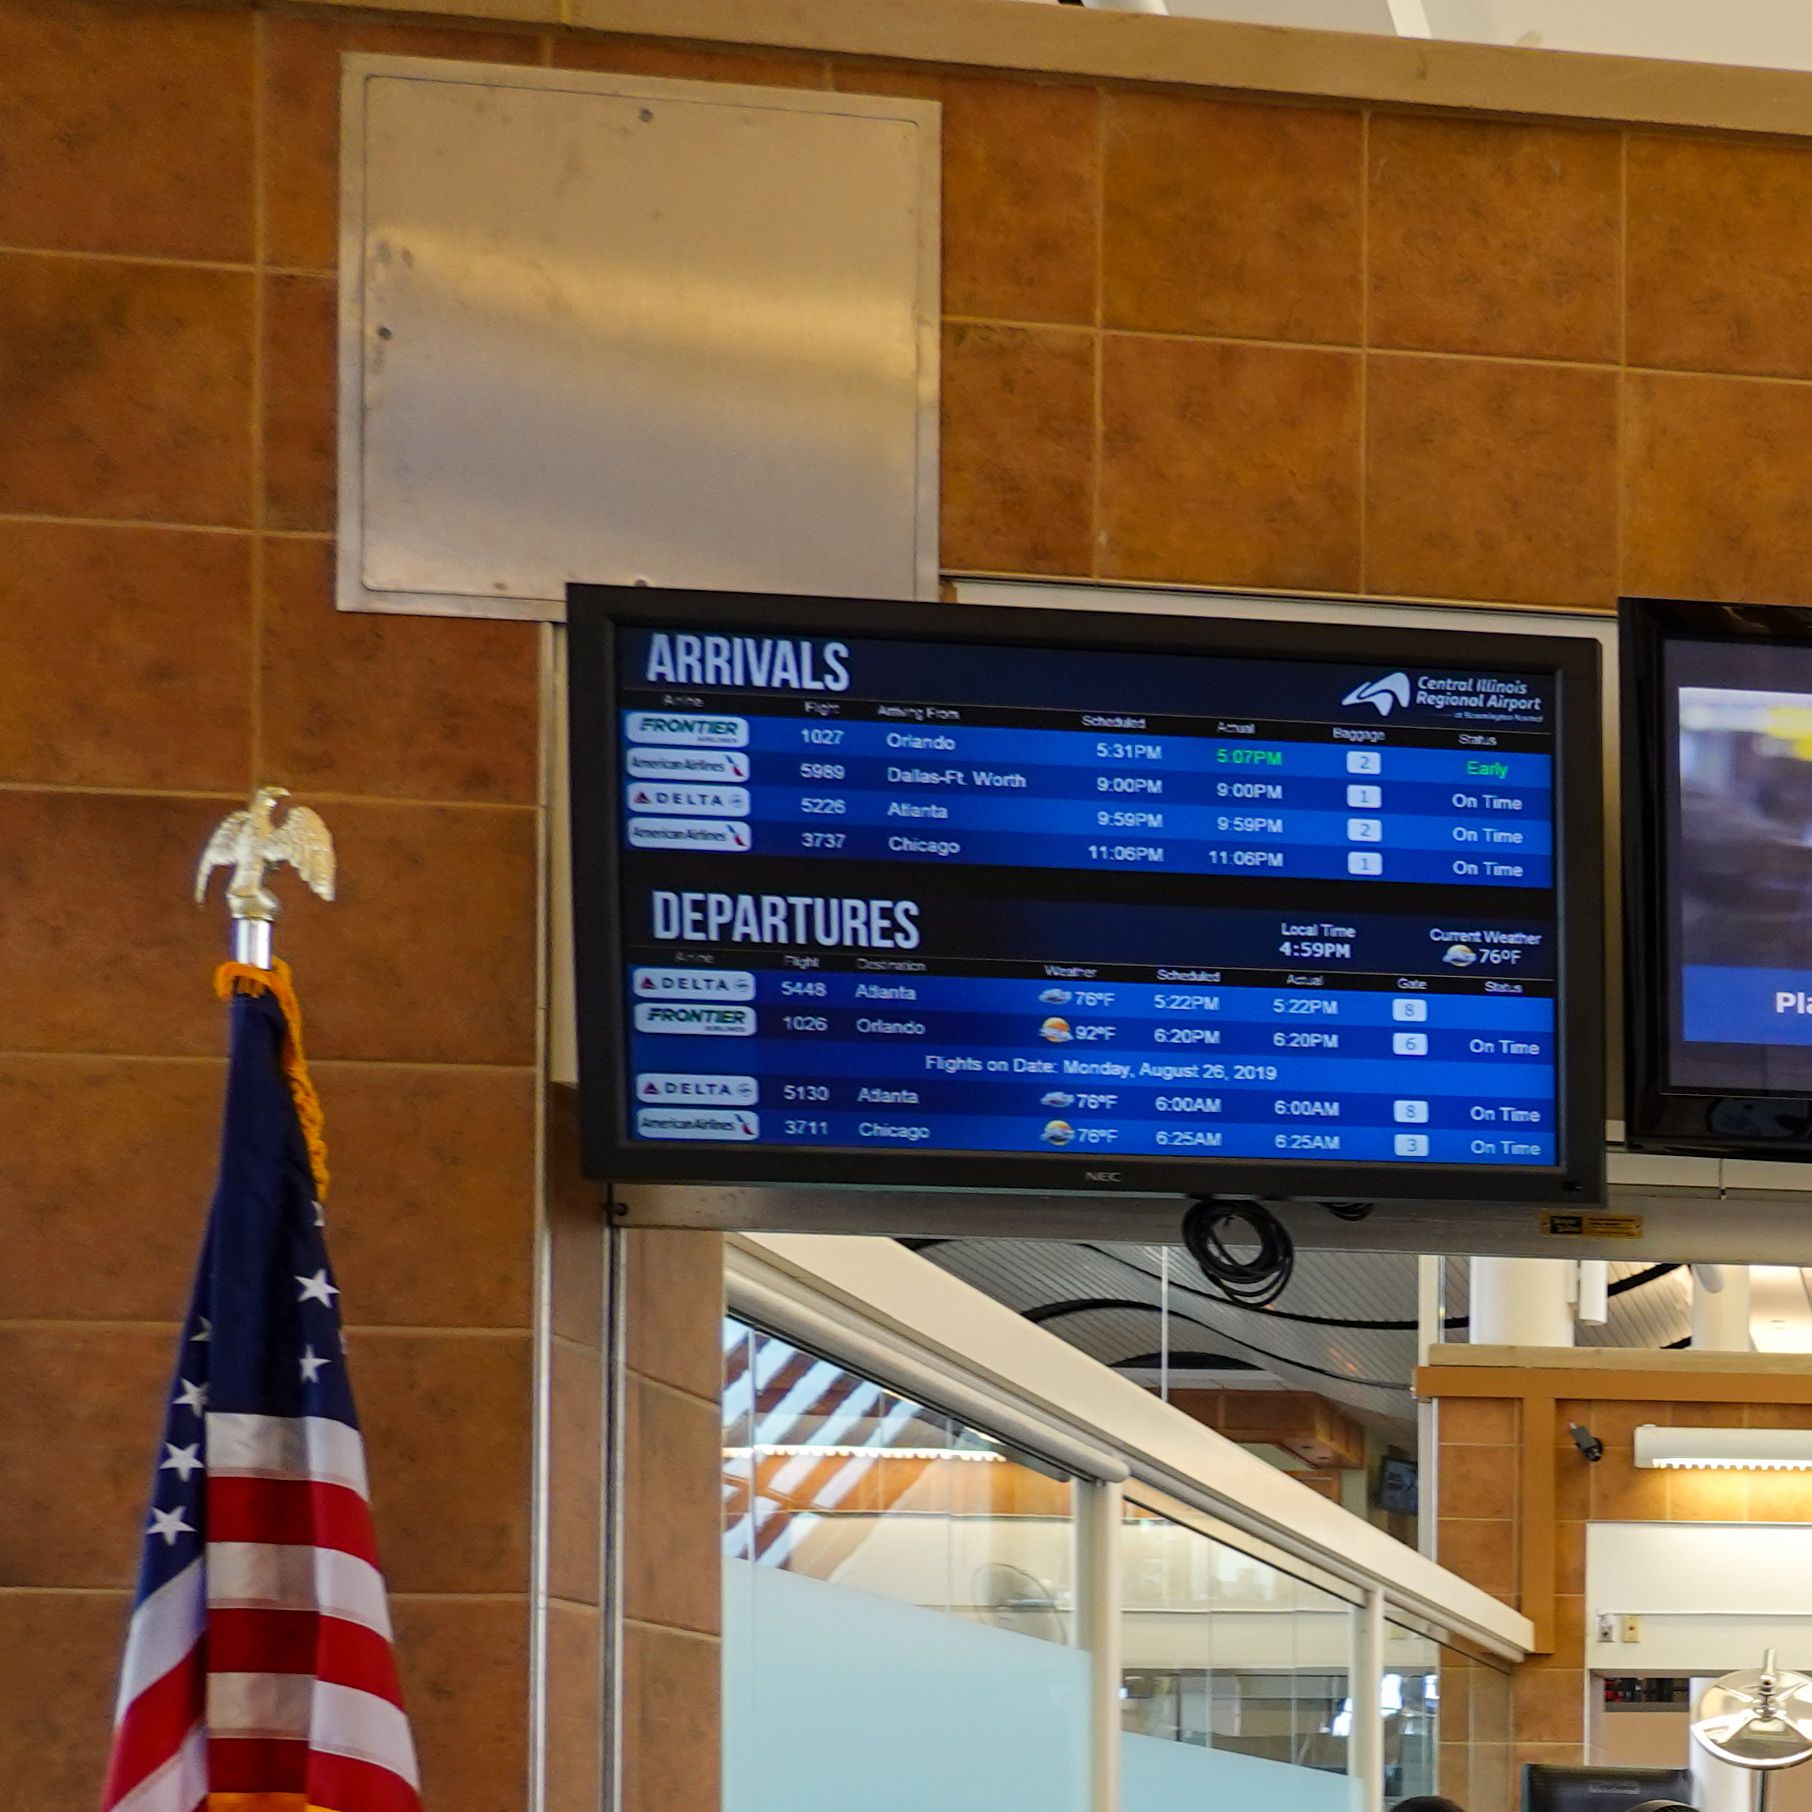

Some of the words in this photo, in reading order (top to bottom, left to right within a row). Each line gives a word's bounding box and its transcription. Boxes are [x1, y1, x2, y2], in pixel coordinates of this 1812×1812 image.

[647, 633, 850, 691] ARRIVALS
[1418, 676, 1473, 691] Central
[1476, 679, 1527, 694] Illinois
[1416, 691, 1484, 708] Regional
[1486, 695, 1541, 711] Airport
[640, 719, 738, 736] FRONTIER
[1082, 715, 1146, 729] Scheduled
[802, 729, 844, 744] 1027
[886, 733, 956, 750] Orlando
[1333, 728, 1386, 742] Baggage
[1458, 733, 1497, 746] Status
[1097, 742, 1162, 760] 5:31PM
[1216, 749, 1282, 766] 5:07PM
[632, 757, 683, 770] American
[684, 758, 724, 771] Airlines
[1359, 756, 1370, 770] 2
[1467, 761, 1508, 779] Early
[972, 771, 1027, 788] Worth
[1097, 777, 1162, 794] 9:00PM
[657, 792, 724, 807] DELTA
[1217, 782, 1282, 800] 9:00PM
[1360, 790, 1370, 803] 1
[887, 802, 948, 818] Atlanta
[1452, 794, 1478, 808] On
[1482, 795, 1522, 811] Time
[1097, 811, 1162, 828] 9:59PM
[1217, 816, 1283, 833] 9:59PM
[633, 826, 684, 841] American
[686, 828, 726, 842] Airlines
[1360, 824, 1370, 837] 2
[1452, 828, 1478, 842] On
[1483, 829, 1523, 844] Time
[802, 833, 846, 848] 3737
[888, 836, 960, 856] Chicago
[1089, 845, 1164, 862] 11:06PM
[1209, 850, 1283, 867] 11:06PM
[1360, 857, 1370, 871] 1
[1453, 861, 1478, 876] On
[1483, 863, 1523, 878] Time
[652, 890, 920, 950] DEPARTURES
[1281, 923, 1319, 937] Local
[1320, 925, 1356, 939] Time
[1430, 929, 1479, 944] Current
[1482, 931, 1542, 947] Weather
[1279, 941, 1351, 959] 4:59PM
[784, 955, 820, 970] Flight
[1157, 968, 1221, 983] Scheduled
[1398, 977, 1427, 990] Gate
[662, 977, 728, 992] DELTA
[781, 981, 827, 996] 5448
[855, 984, 916, 1000] Atlanta
[1484, 980, 1523, 994] Status
[1154, 994, 1219, 1012] 5:22PM
[1273, 998, 1338, 1016] 5:22PM
[648, 1008, 745, 1025] FRONTIER
[783, 1016, 828, 1031] 1026
[856, 1018, 926, 1035] Orlando
[1154, 1028, 1220, 1045] 6:20PM
[1274, 1032, 1338, 1049] 6:20PM
[1405, 1038, 1415, 1051] 6
[1470, 1039, 1495, 1055] On
[1500, 1041, 1540, 1056] Time
[925, 1055, 982, 1074] Flights
[987, 1059, 1009, 1072] on
[1012, 1058, 1056, 1074] Date:
[1063, 1060, 1135, 1081] Monday,
[1139, 1062, 1198, 1082] August
[1203, 1064, 1229, 1082] 26,
[1233, 1066, 1277, 1081] 2019
[664, 1081, 730, 1096] DELTA
[857, 1087, 920, 1104] Atlanta
[1156, 1097, 1222, 1114] 6:00AM
[1275, 1100, 1340, 1117] 6:00AM
[641, 1115, 692, 1130] American
[694, 1117, 734, 1131] Airlines
[1471, 1106, 1496, 1121] On
[1500, 1108, 1541, 1123] Time
[785, 1120, 828, 1135] 3711
[859, 1122, 930, 1141] Chicago
[1156, 1131, 1222, 1147] 6:25AM
[1275, 1134, 1341, 1151] 6:25AM
[1471, 1140, 1495, 1155] On
[1500, 1141, 1541, 1157] Time
[1085, 1171, 1122, 1183] NEC
